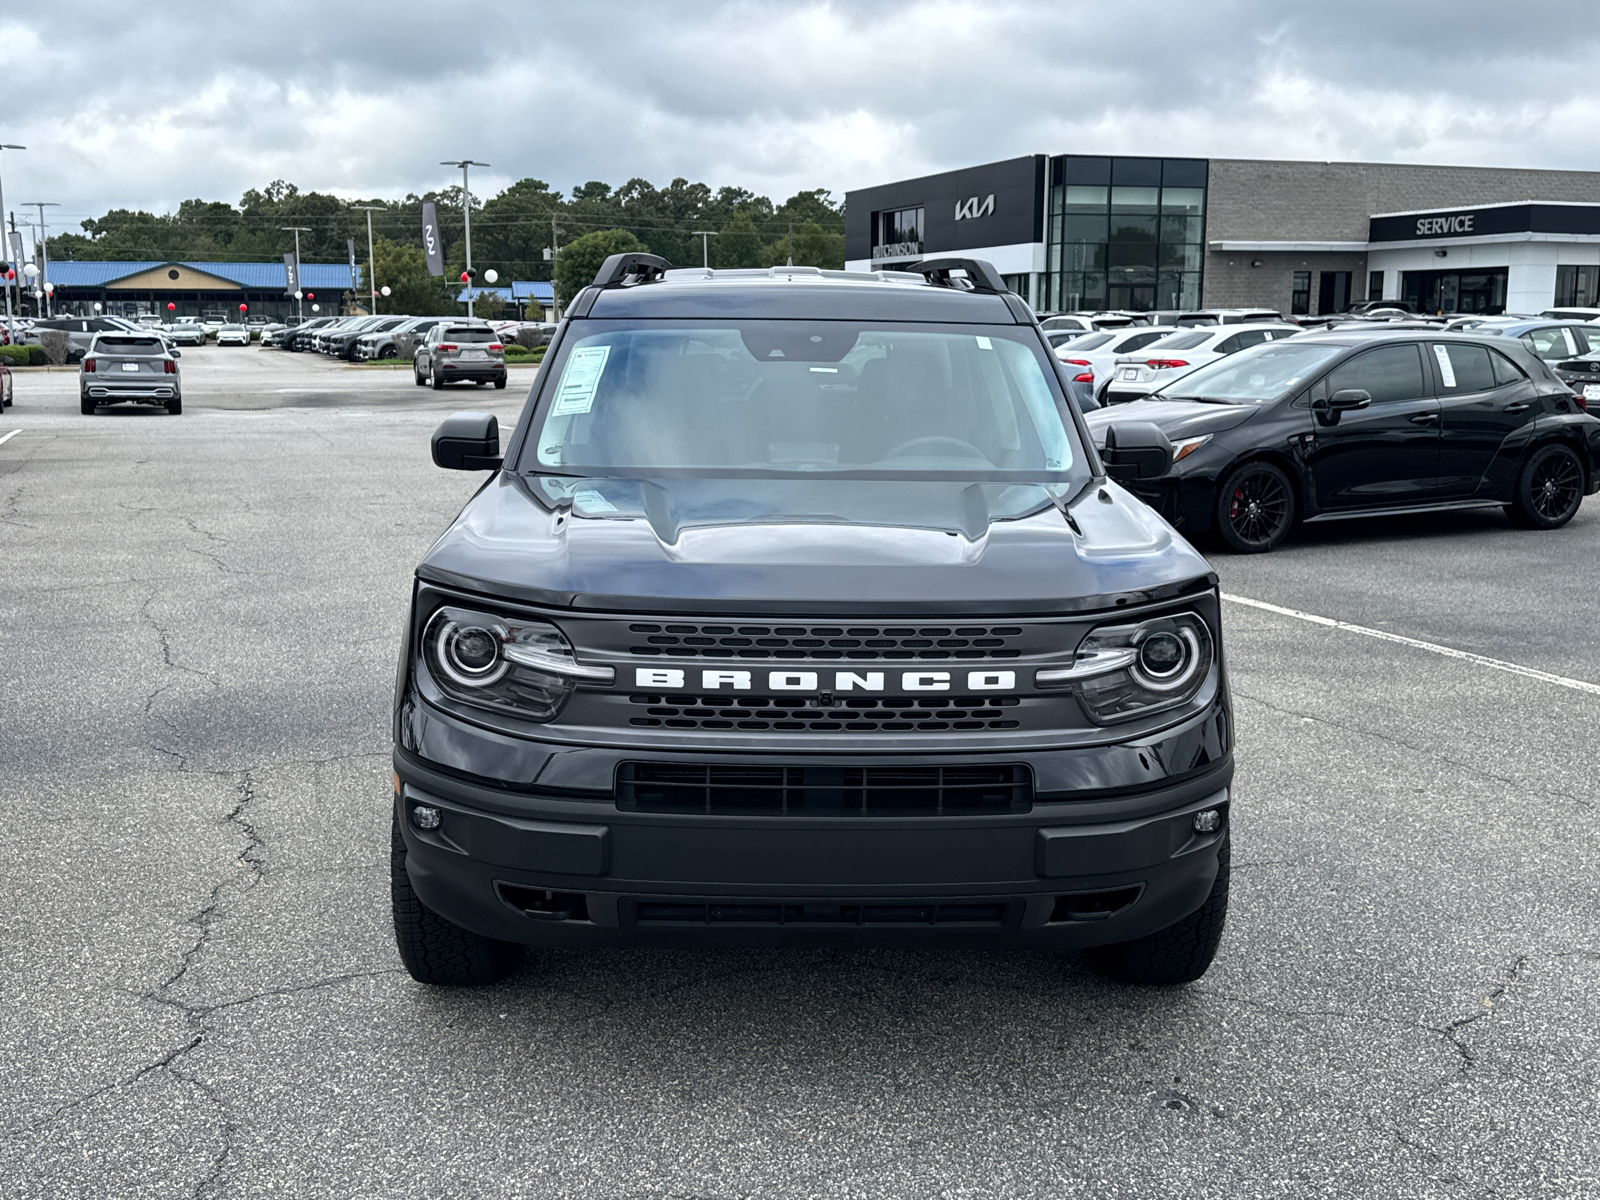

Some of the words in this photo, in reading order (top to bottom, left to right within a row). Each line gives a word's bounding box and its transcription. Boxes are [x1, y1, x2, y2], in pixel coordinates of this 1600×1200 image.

[955, 194, 995, 220] KIA
[1416, 215, 1474, 235] SERVICE
[636, 668, 1016, 691] BRONCO
